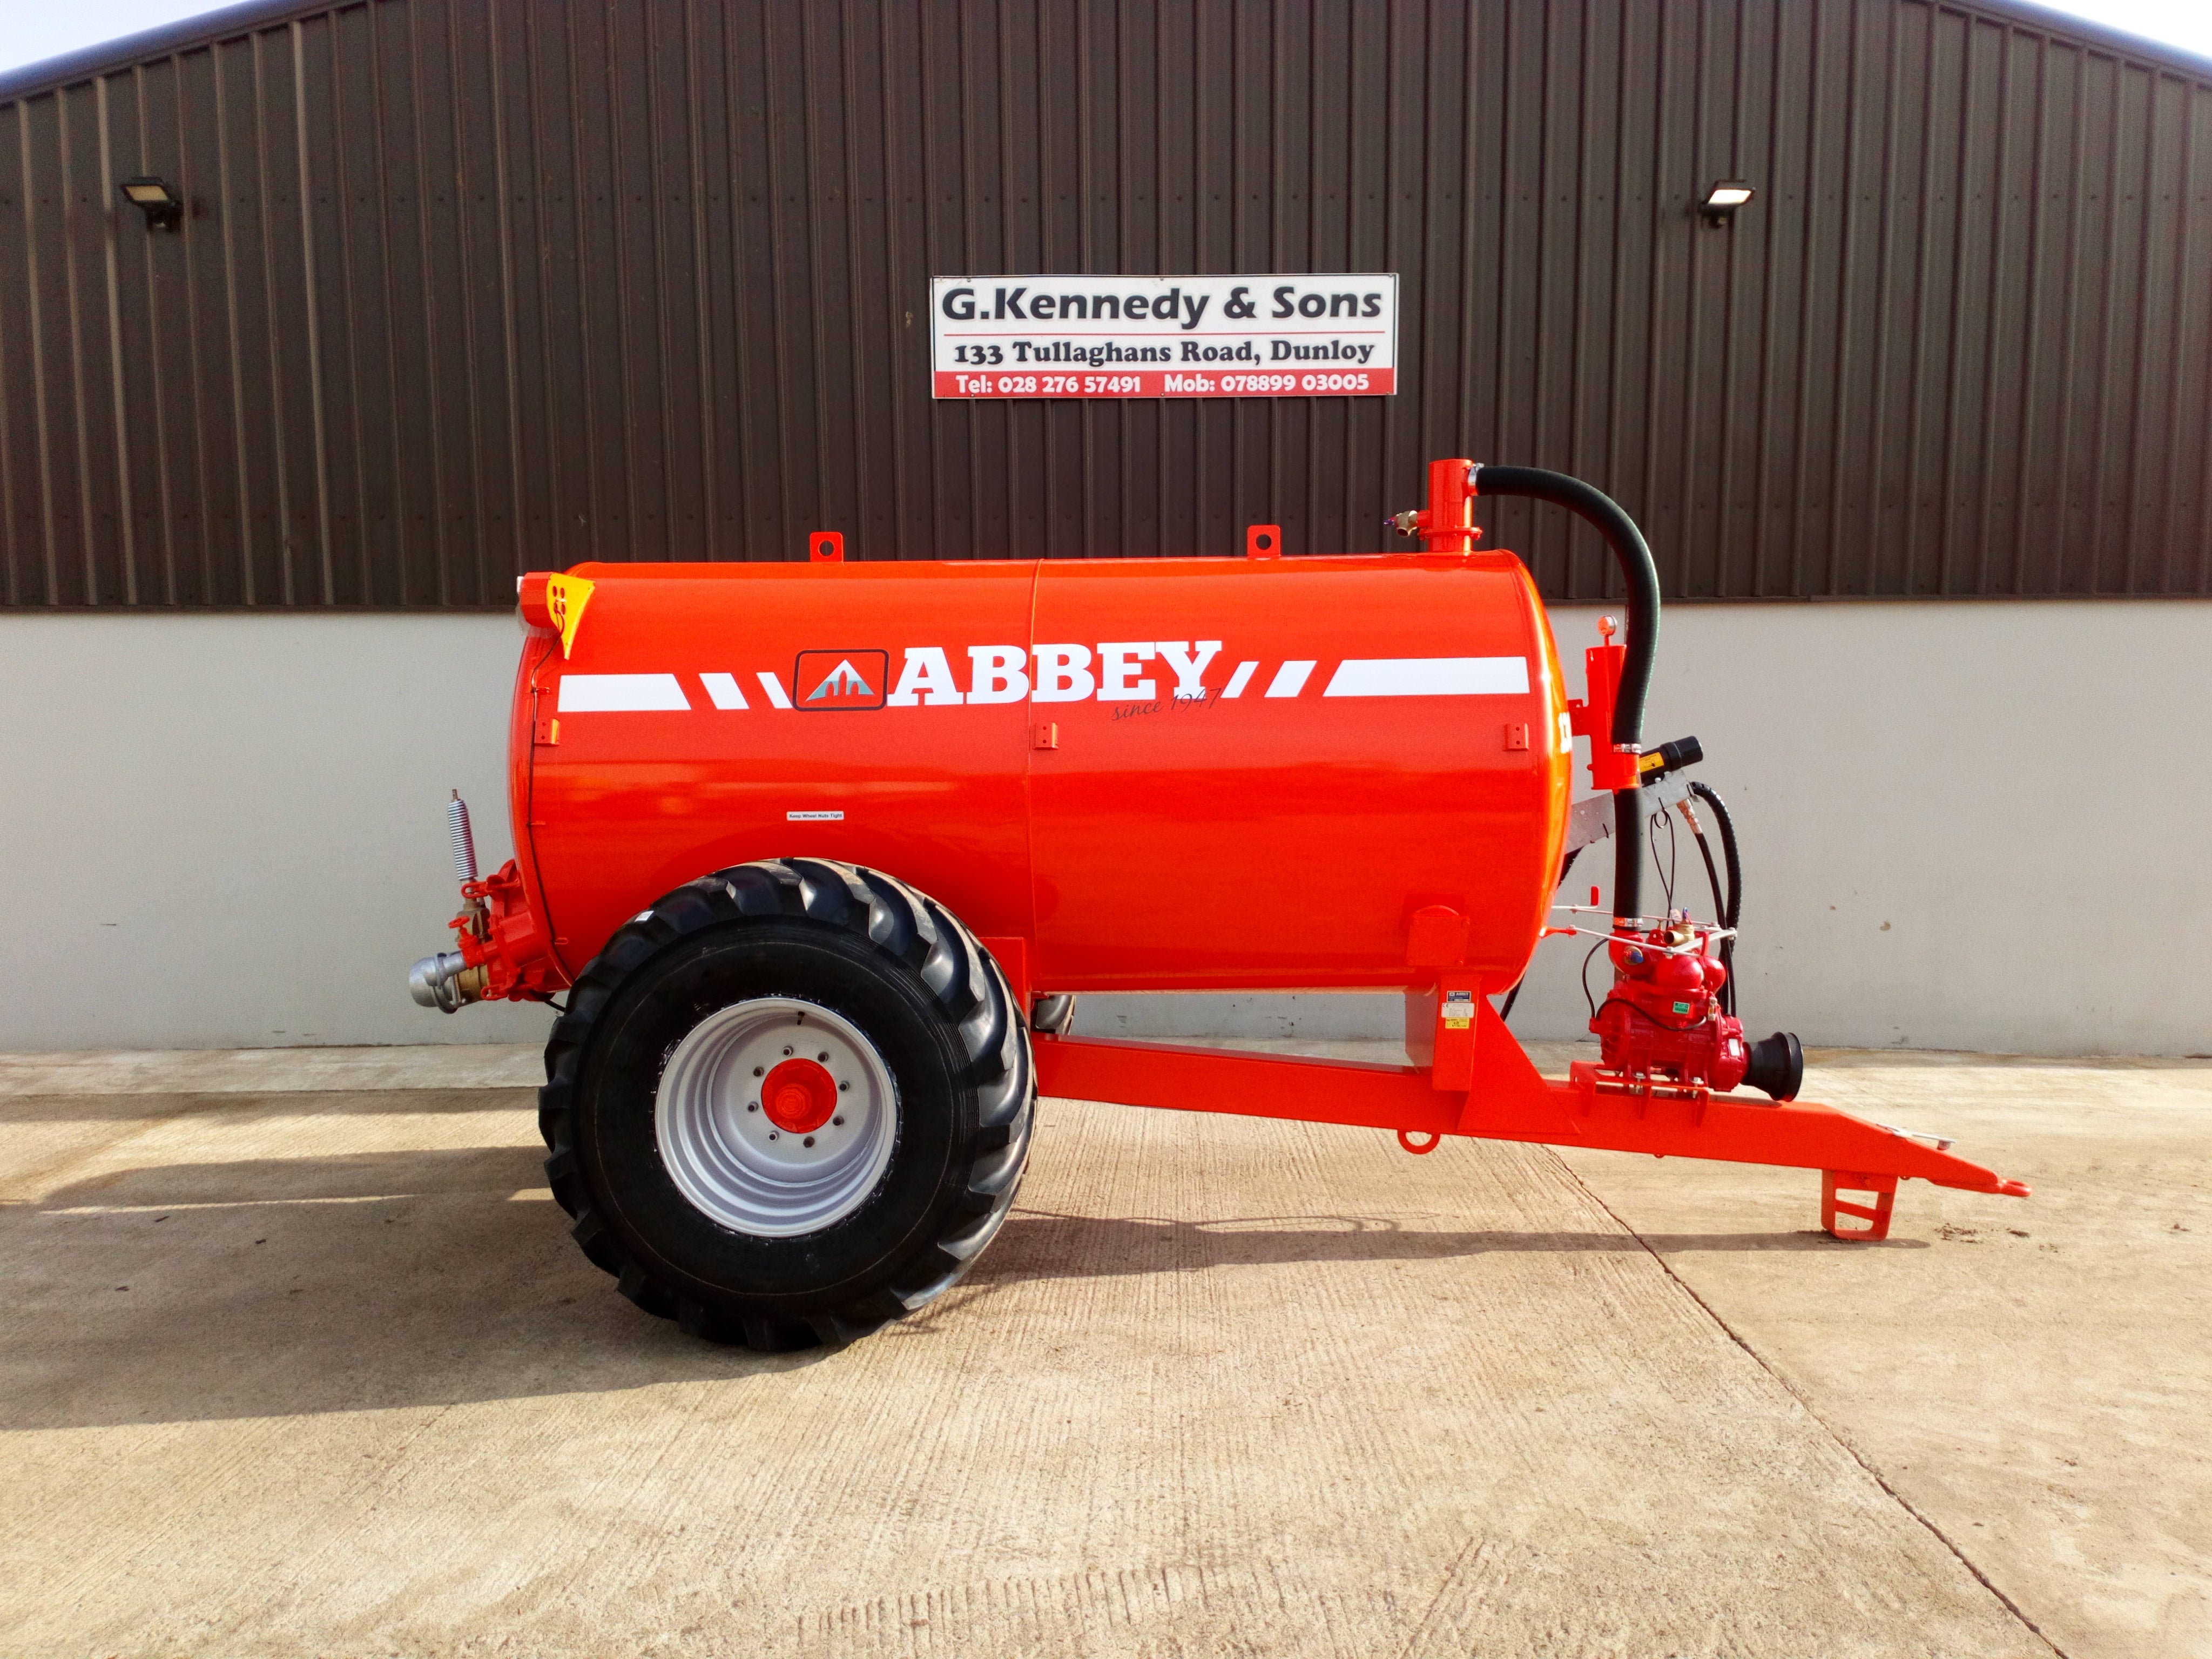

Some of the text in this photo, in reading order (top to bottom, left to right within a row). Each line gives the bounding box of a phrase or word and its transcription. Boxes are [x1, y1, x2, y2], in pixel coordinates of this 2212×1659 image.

[942, 286, 1381, 330] G.Kennedy & Sons
[955, 340, 1374, 367] 133 Tullaghans Road, Dunloy
[956, 374, 1369, 393] Tel: 028 276 57491 Mob: 078899 03005
[887, 641, 1222, 706] ABBEY
[1112, 687, 1222, 721] since 1947
